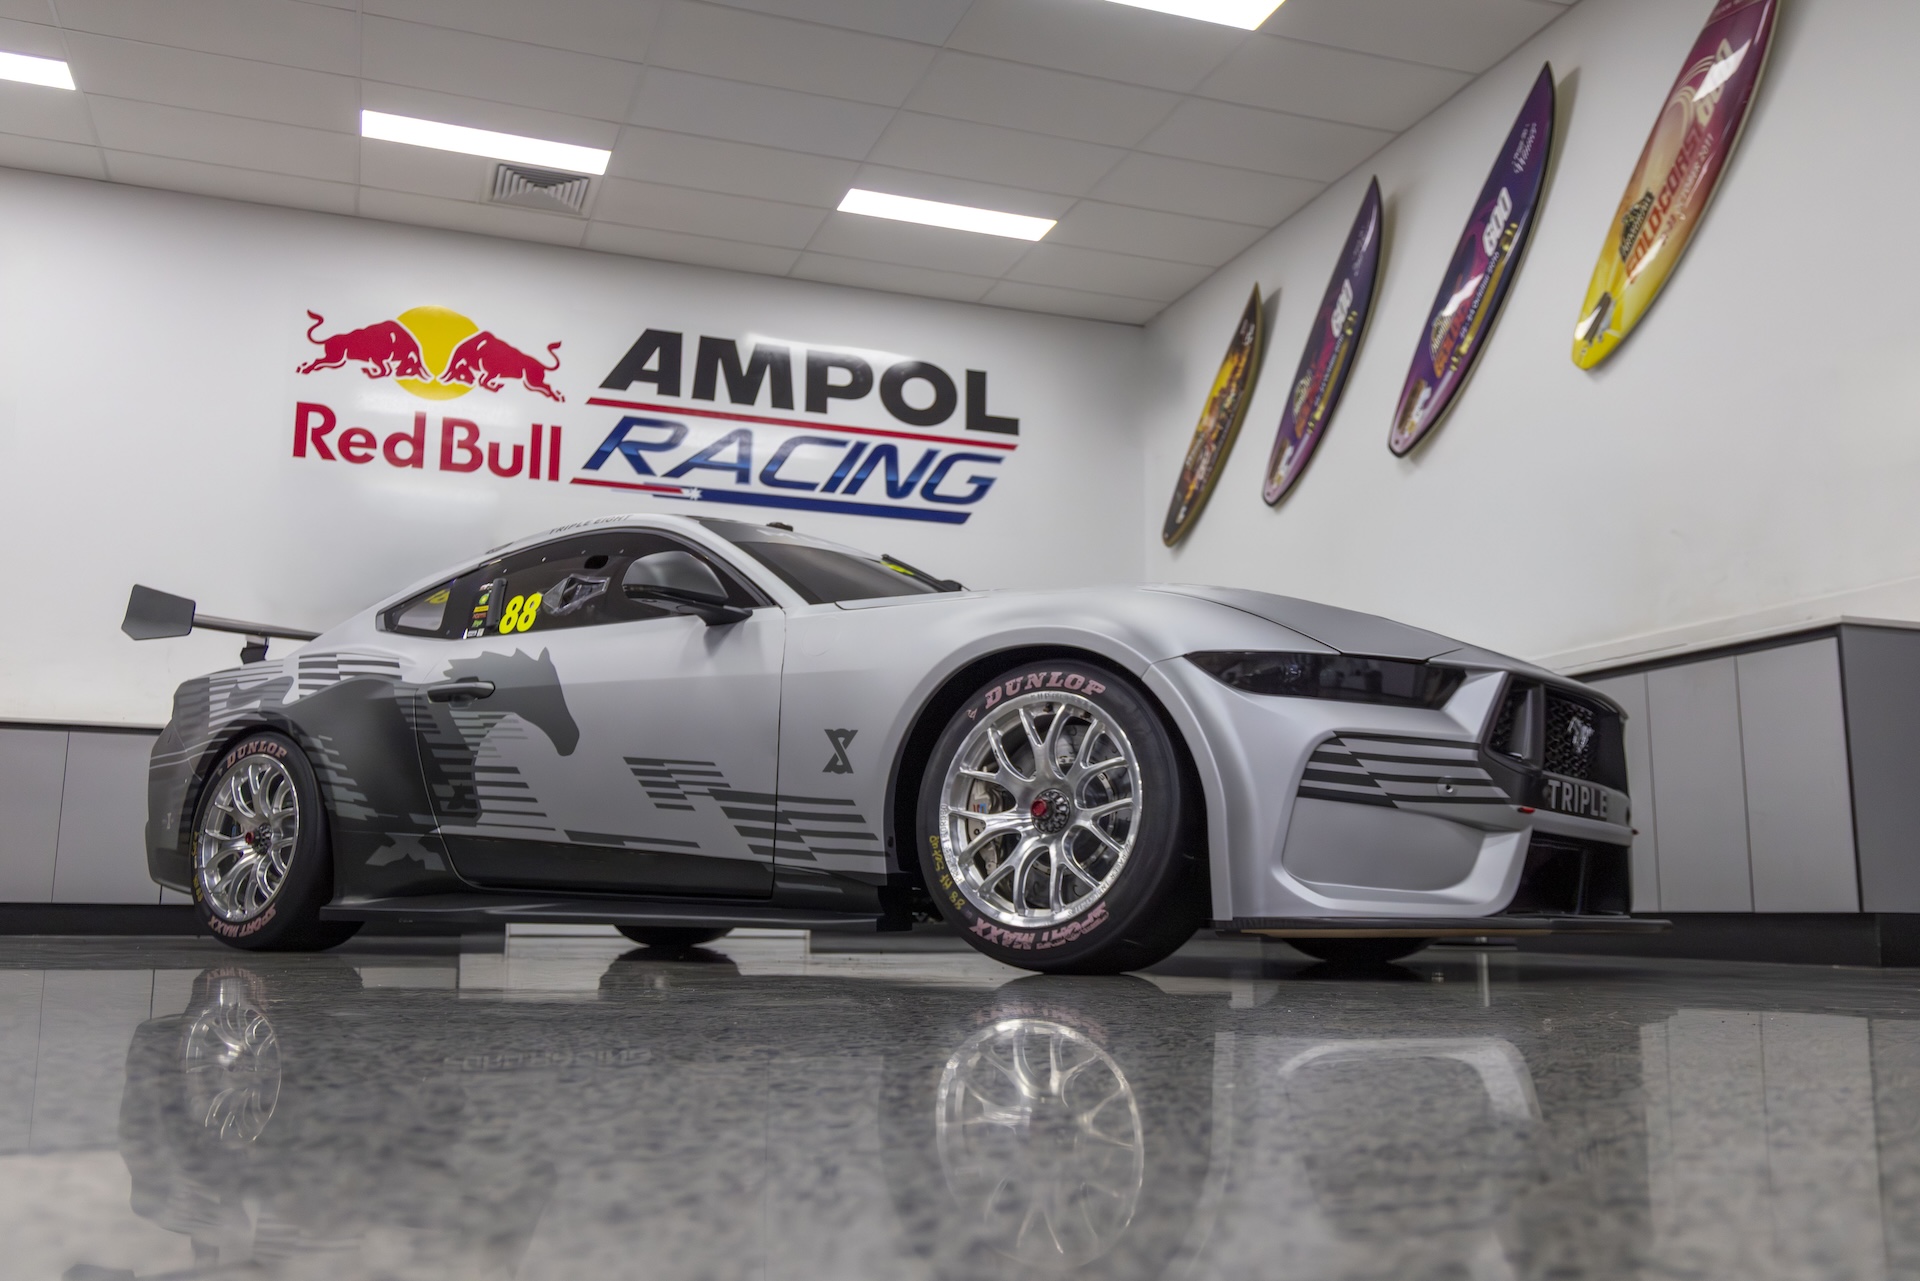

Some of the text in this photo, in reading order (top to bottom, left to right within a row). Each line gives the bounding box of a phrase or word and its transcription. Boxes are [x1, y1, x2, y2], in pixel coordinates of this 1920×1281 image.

[1656, 124, 1704, 214] COAST
[1481, 186, 1514, 257] 600
[600, 328, 1019, 436] AMPOL
[292, 401, 562, 481] Red Bull
[582, 416, 1004, 505] RACING
[549, 514, 633, 535] TRIPLE EIGHT
[498, 592, 543, 635] 88
[984, 671, 1107, 710] DUNLOP
[226, 740, 288, 769] DUNLOP
[1548, 779, 1608, 818] TRIPLE
[207, 902, 277, 938] SPORT MAXX
[968, 901, 1110, 950] SPORT MAXX
